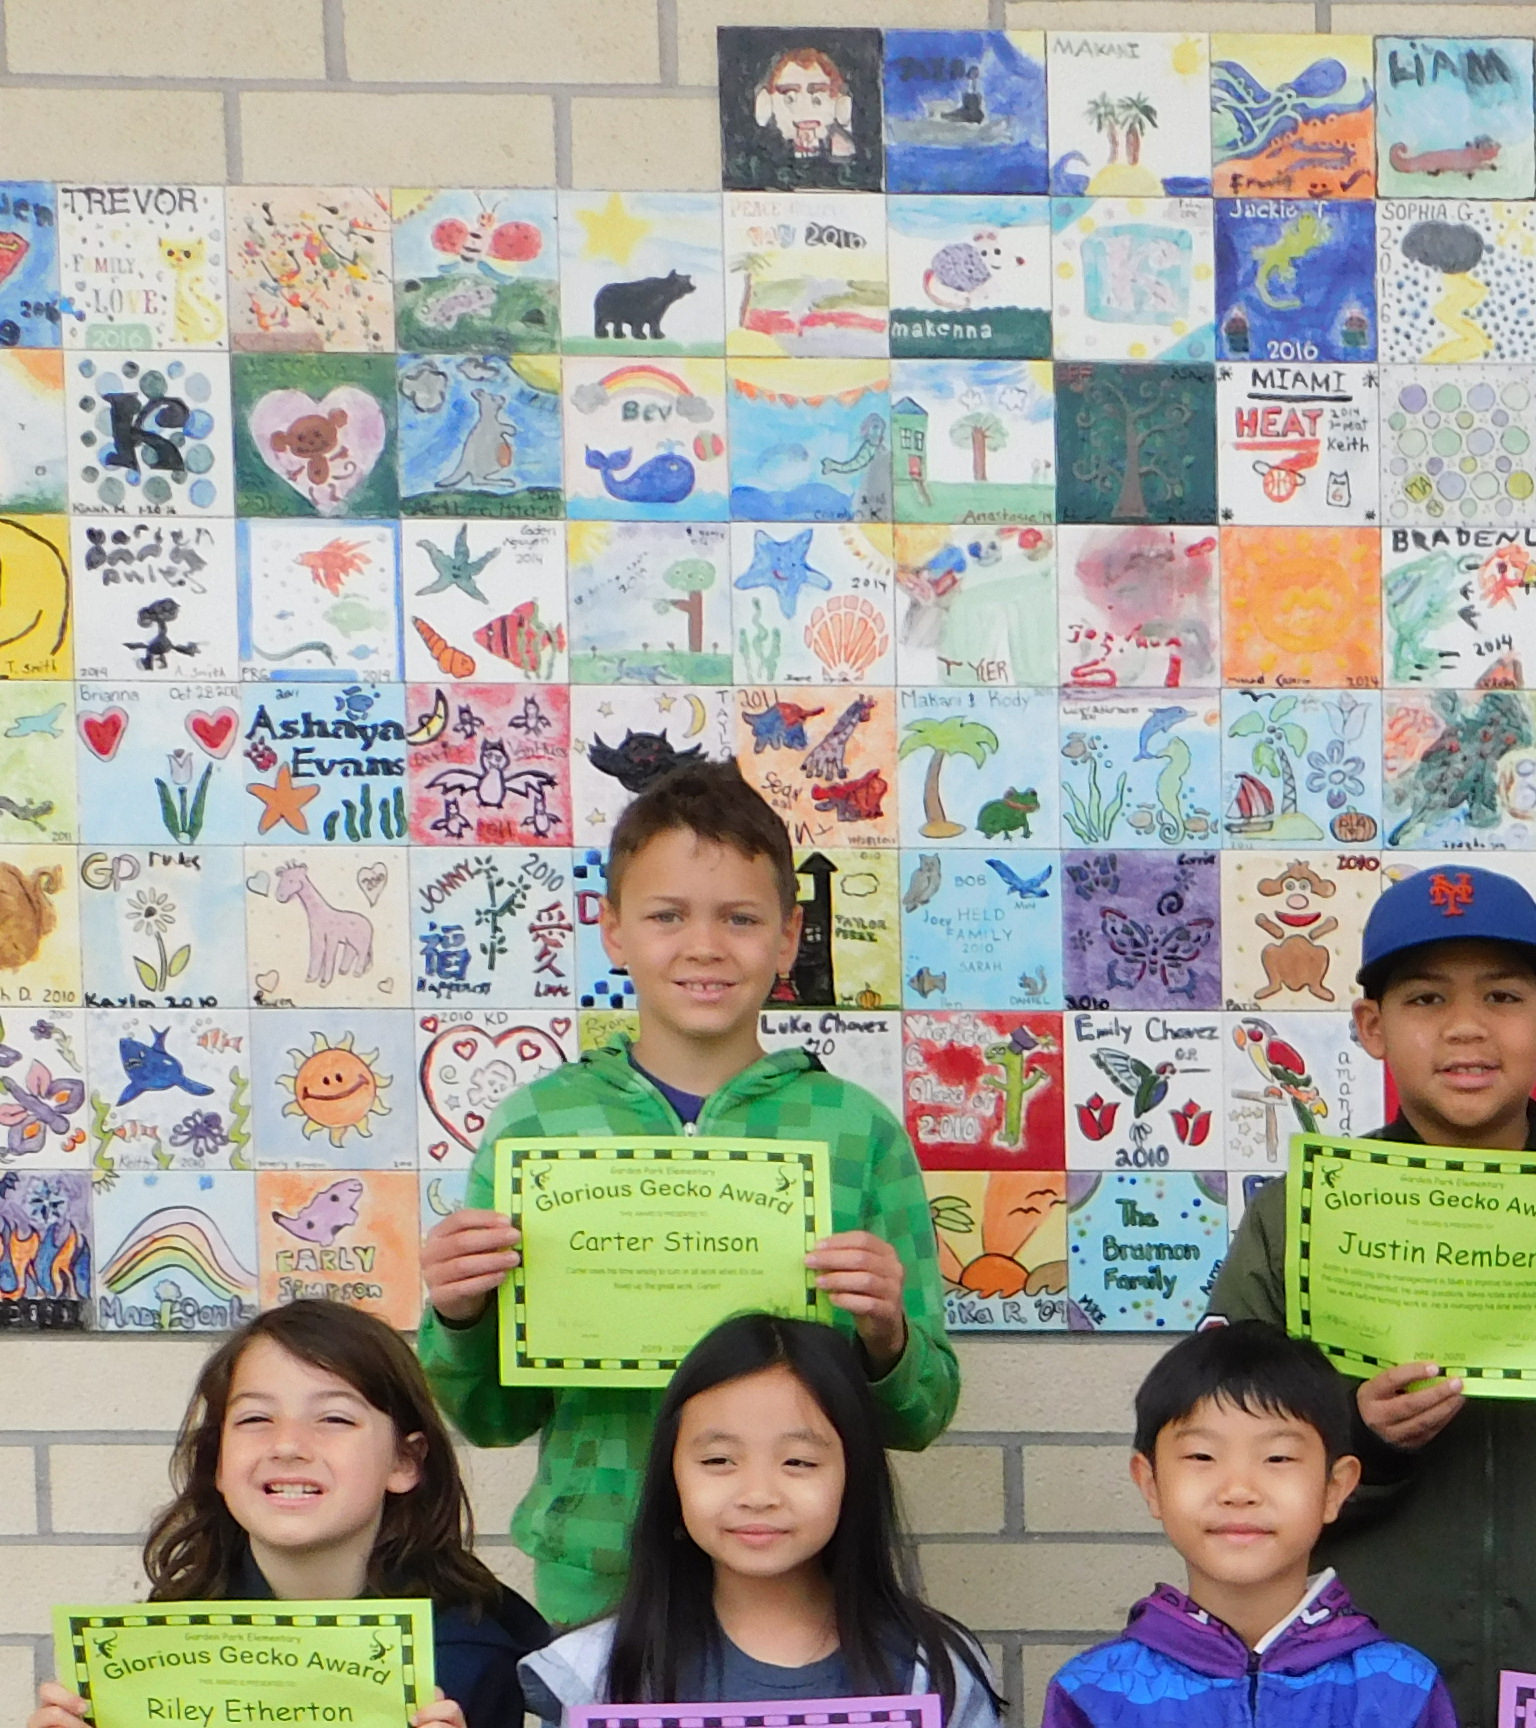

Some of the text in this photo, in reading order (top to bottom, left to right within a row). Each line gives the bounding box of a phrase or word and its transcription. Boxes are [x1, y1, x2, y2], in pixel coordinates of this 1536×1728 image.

[1054, 38, 1141, 59] MAKANI
[62, 187, 199, 216] TREVOR
[1229, 199, 1298, 219] Jackie
[1382, 202, 1447, 220] SOPHIA
[891, 319, 992, 339] makenna
[1267, 341, 1318, 361] 2016
[1252, 368, 1347, 392] MIAMI
[1235, 407, 1323, 438] HEAT
[1327, 436, 1369, 453] Keith
[81, 686, 139, 701] Brianna
[246, 705, 405, 750] Ashaya
[292, 747, 406, 778] Evans
[521, 853, 564, 892] 2010
[420, 859, 475, 914] JONNY
[957, 908, 1006, 922] HELD
[528, 901, 573, 978] 愛
[946, 928, 1013, 944] FAMILY
[420, 922, 472, 980] 福
[1075, 1016, 1221, 1043] Emily Chavez
[1115, 1146, 1170, 1168] 2010
[535, 1180, 793, 1215] Glorious Gecko Award
[1325, 1188, 1420, 1210] Glorious
[1429, 1190, 1499, 1211] Gecko
[1116, 1199, 1158, 1228] The
[569, 1231, 758, 1252] Carter Stinson
[1103, 1237, 1199, 1262] Brannon
[1339, 1232, 1425, 1263] Justin
[1103, 1267, 1177, 1297] Family
[104, 1646, 391, 1685] Glorious Gecko Award
[149, 1698, 353, 1728] Riley Etherton
